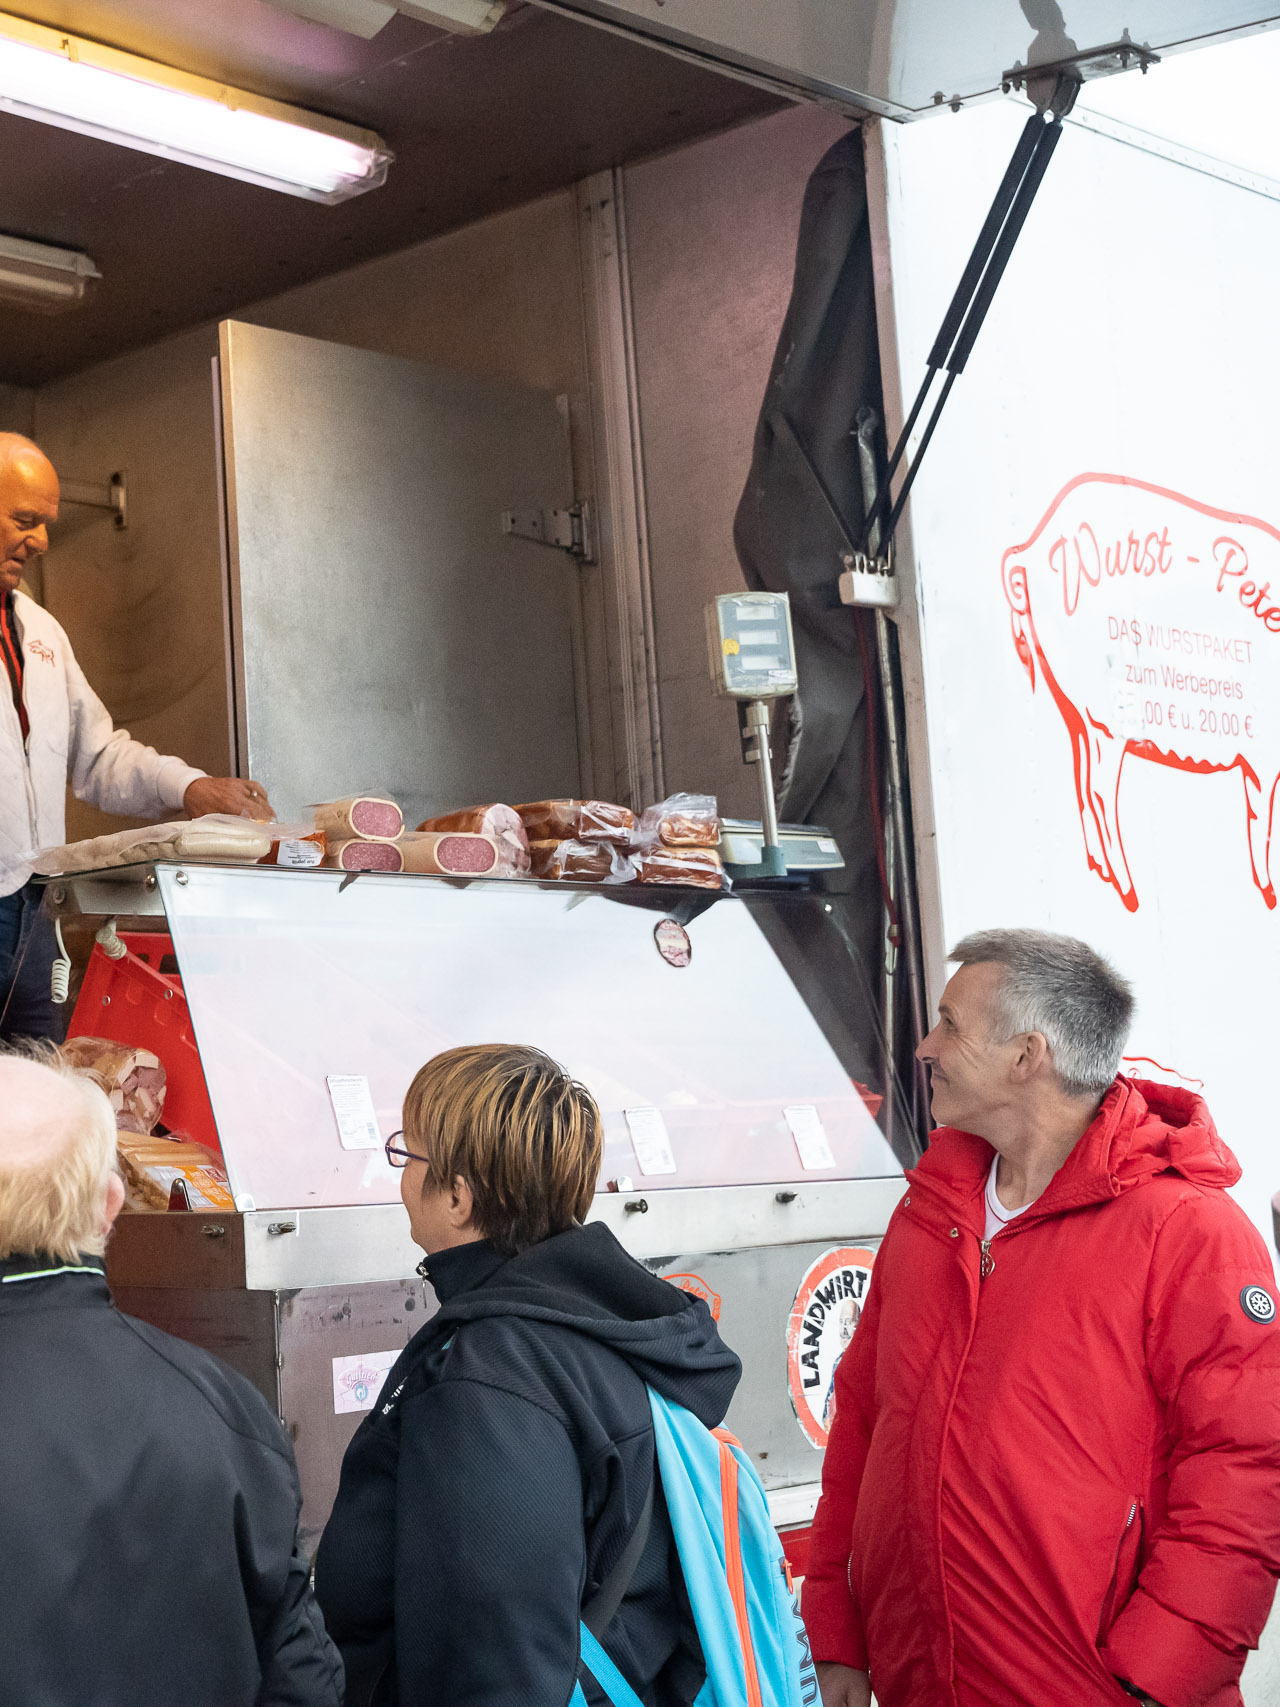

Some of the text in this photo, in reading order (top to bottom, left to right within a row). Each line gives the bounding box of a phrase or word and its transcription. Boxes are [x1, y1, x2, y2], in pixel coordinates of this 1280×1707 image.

[1048, 521, 1173, 617] Wurst
[1108, 616, 1253, 664] DAS WURSTPAKET
[1125, 664, 1244, 701] zum Werbepreis
[1168, 704, 1177, 728] €
[1199, 708, 1240, 739] 20,00
[1245, 715, 1254, 739] €
